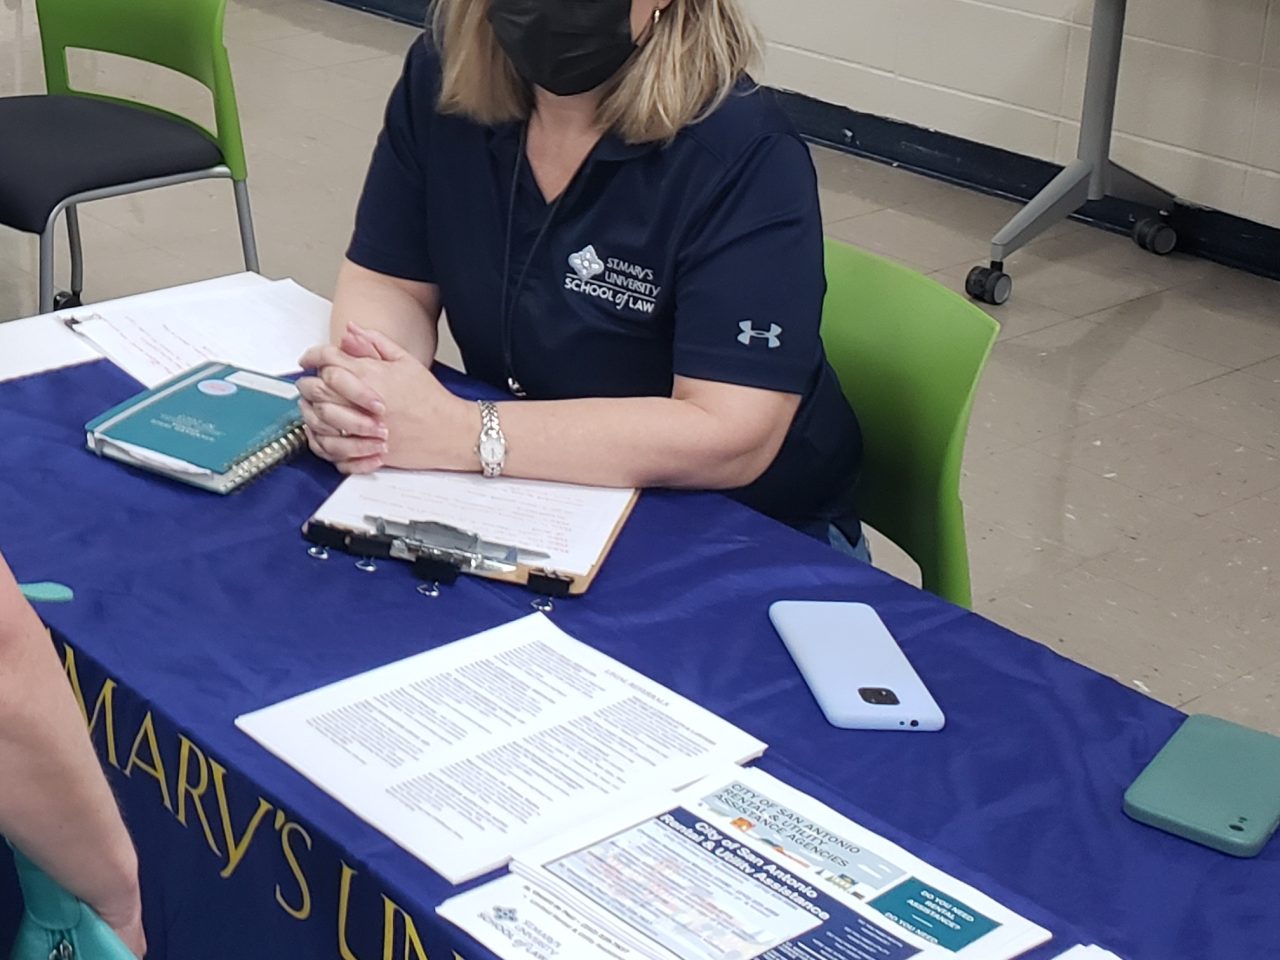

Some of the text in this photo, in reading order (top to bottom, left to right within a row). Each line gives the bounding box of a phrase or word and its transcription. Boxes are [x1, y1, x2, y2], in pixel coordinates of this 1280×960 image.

[564, 277, 655, 313] SCHOOL of LAW
[604, 270, 661, 297] UNIVERSITY
[63, 642, 313, 921] MARY'S
[713, 794, 850, 868] ASSISTANCE AGENCIES
[723, 788, 767, 816] RENTAL
[781, 818, 830, 847] UTILITY
[731, 783, 862, 854] CITY OF SAN ANTONIO
[659, 813, 705, 844] Rental
[714, 845, 756, 875] Utility
[753, 871, 831, 921] Assistance
[694, 821, 818, 899] City of San Antonio
[950, 905, 975, 923] NEED
